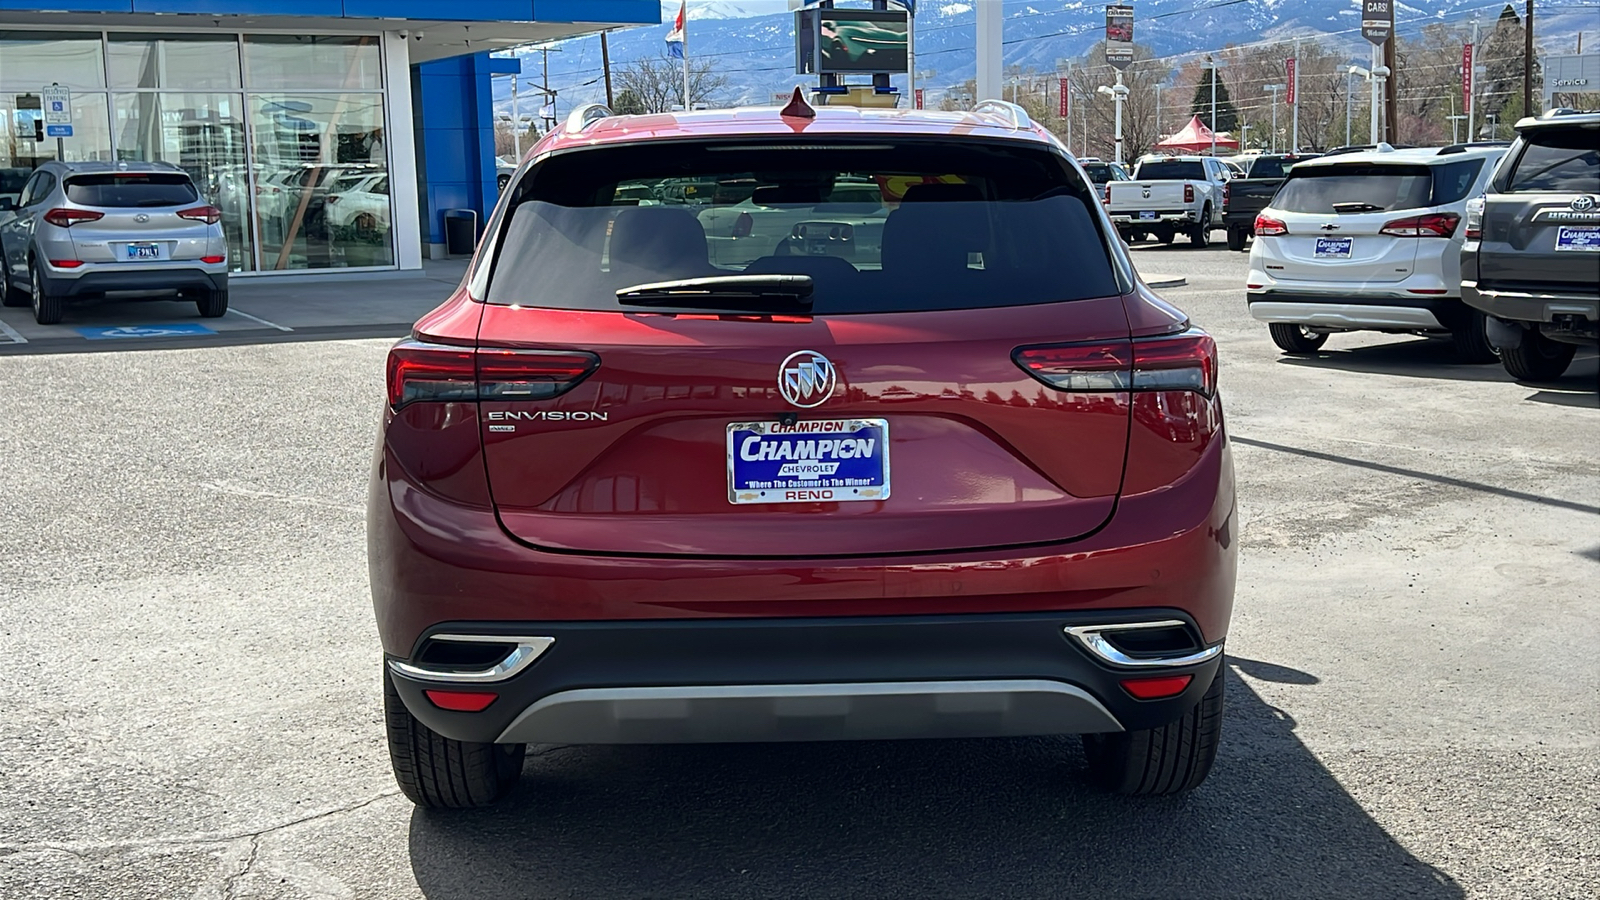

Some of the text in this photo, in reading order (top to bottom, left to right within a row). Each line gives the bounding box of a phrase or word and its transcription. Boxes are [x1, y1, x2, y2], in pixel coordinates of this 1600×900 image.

[1367, 2, 1388, 13] CARS!
[1551, 78, 1587, 87] Service
[1318, 240, 1350, 249] CHAMPION
[488, 411, 608, 421] ENVISION
[770, 421, 844, 433] CHAMPION
[740, 435, 875, 461] CHAMPION
[782, 464, 835, 473] CHEVROLET
[773, 480, 786, 488] The
[788, 478, 821, 488] Customer
[831, 478, 843, 486] The
[785, 490, 833, 500] RENO
